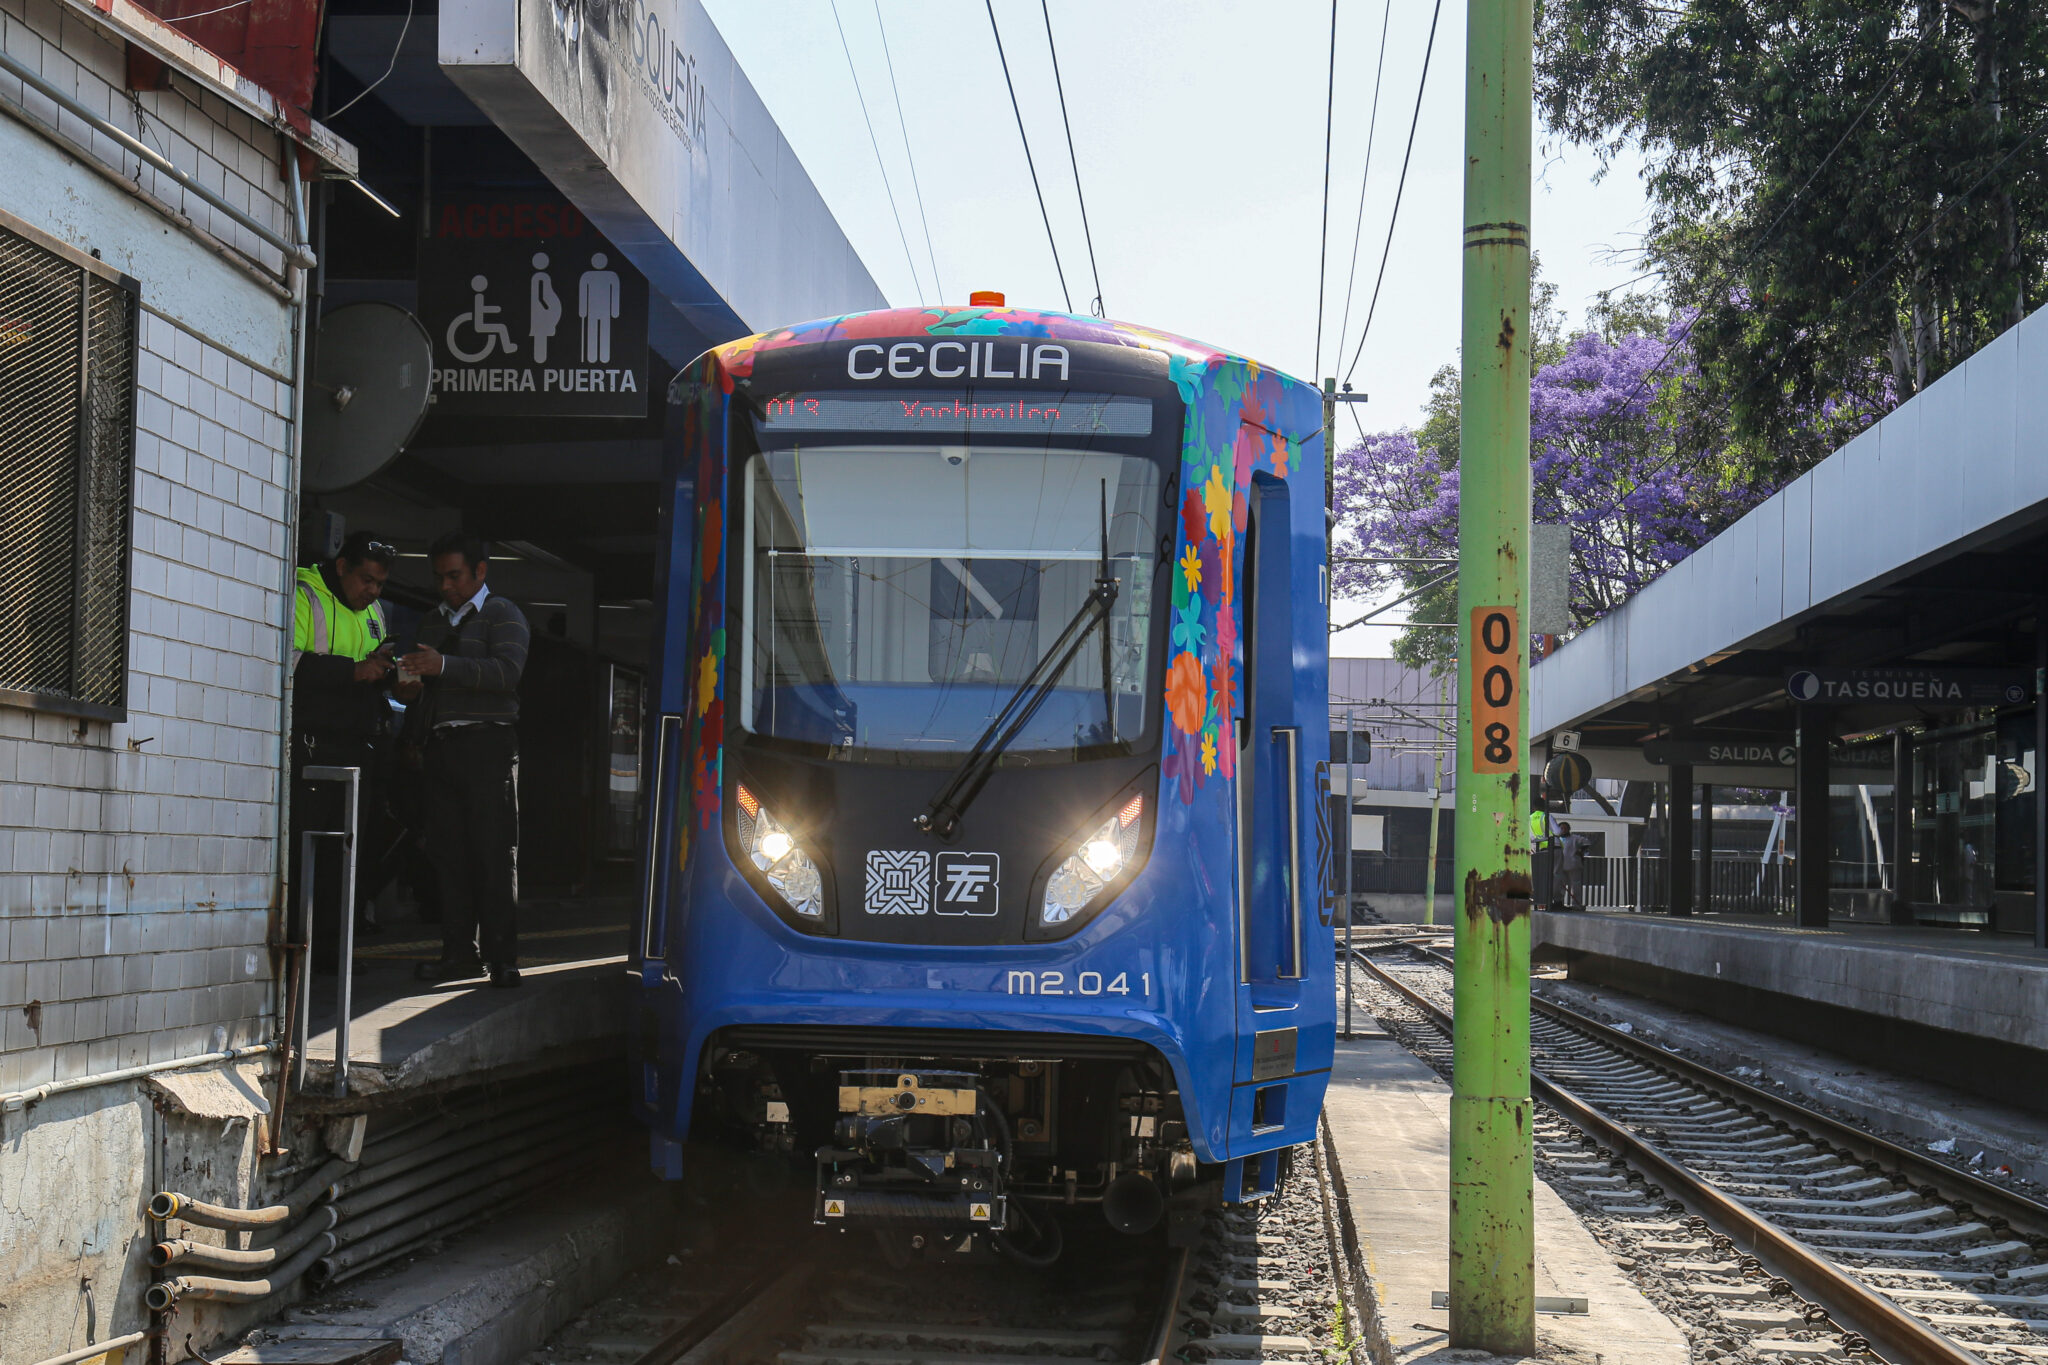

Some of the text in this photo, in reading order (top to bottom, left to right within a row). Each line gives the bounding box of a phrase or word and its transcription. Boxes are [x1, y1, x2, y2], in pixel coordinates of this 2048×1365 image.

[438, 203, 585, 238] ACCESO
[847, 341, 1070, 381] CECILIA
[431, 368, 637, 393] PRIMERA PUERTA
[1851, 669, 1936, 678] TERMINAL
[1823, 678, 1963, 699] TASQUEÑA
[1562, 734, 1570, 747] 6
[1709, 745, 1774, 761] SALIDA
